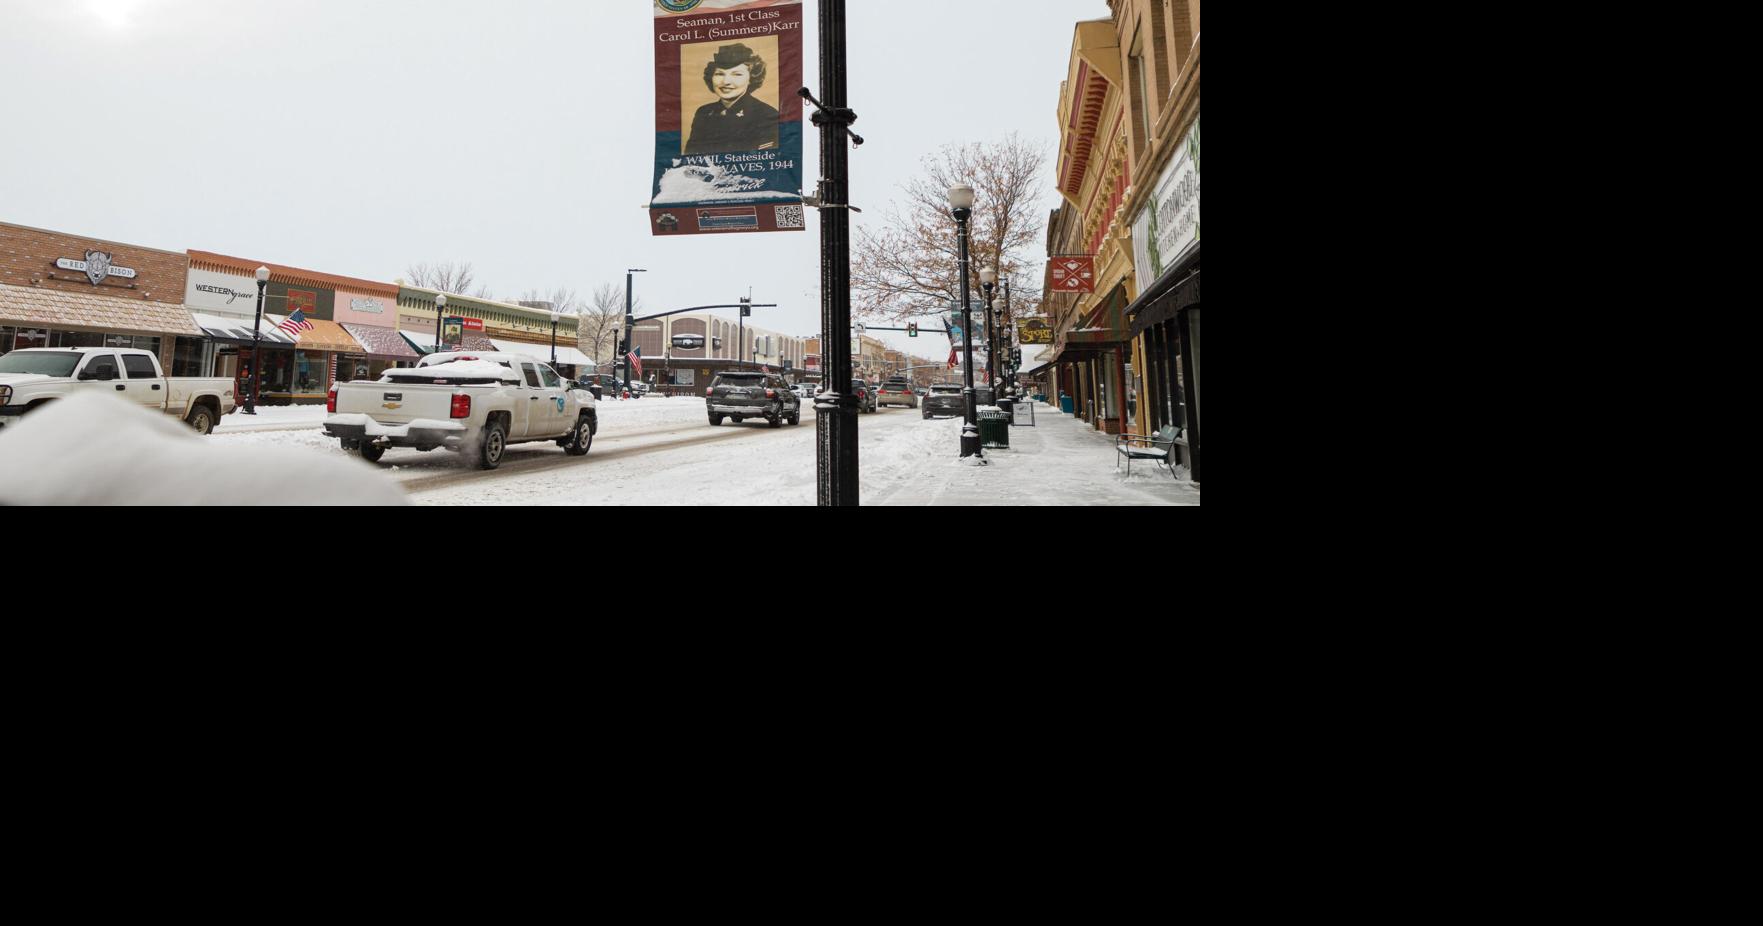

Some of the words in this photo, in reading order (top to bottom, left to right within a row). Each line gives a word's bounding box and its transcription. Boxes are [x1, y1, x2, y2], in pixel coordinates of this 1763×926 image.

[676, 17, 726, 28] Seaman,
[729, 14, 746, 23] 1st
[749, 10, 780, 21] Class
[659, 31, 691, 42] Carol
[694, 30, 705, 40] L.
[724, 151, 776, 163] Stateside
[769, 160, 794, 171] 1944
[69, 260, 85, 269] RED
[110, 267, 133, 276] BISON
